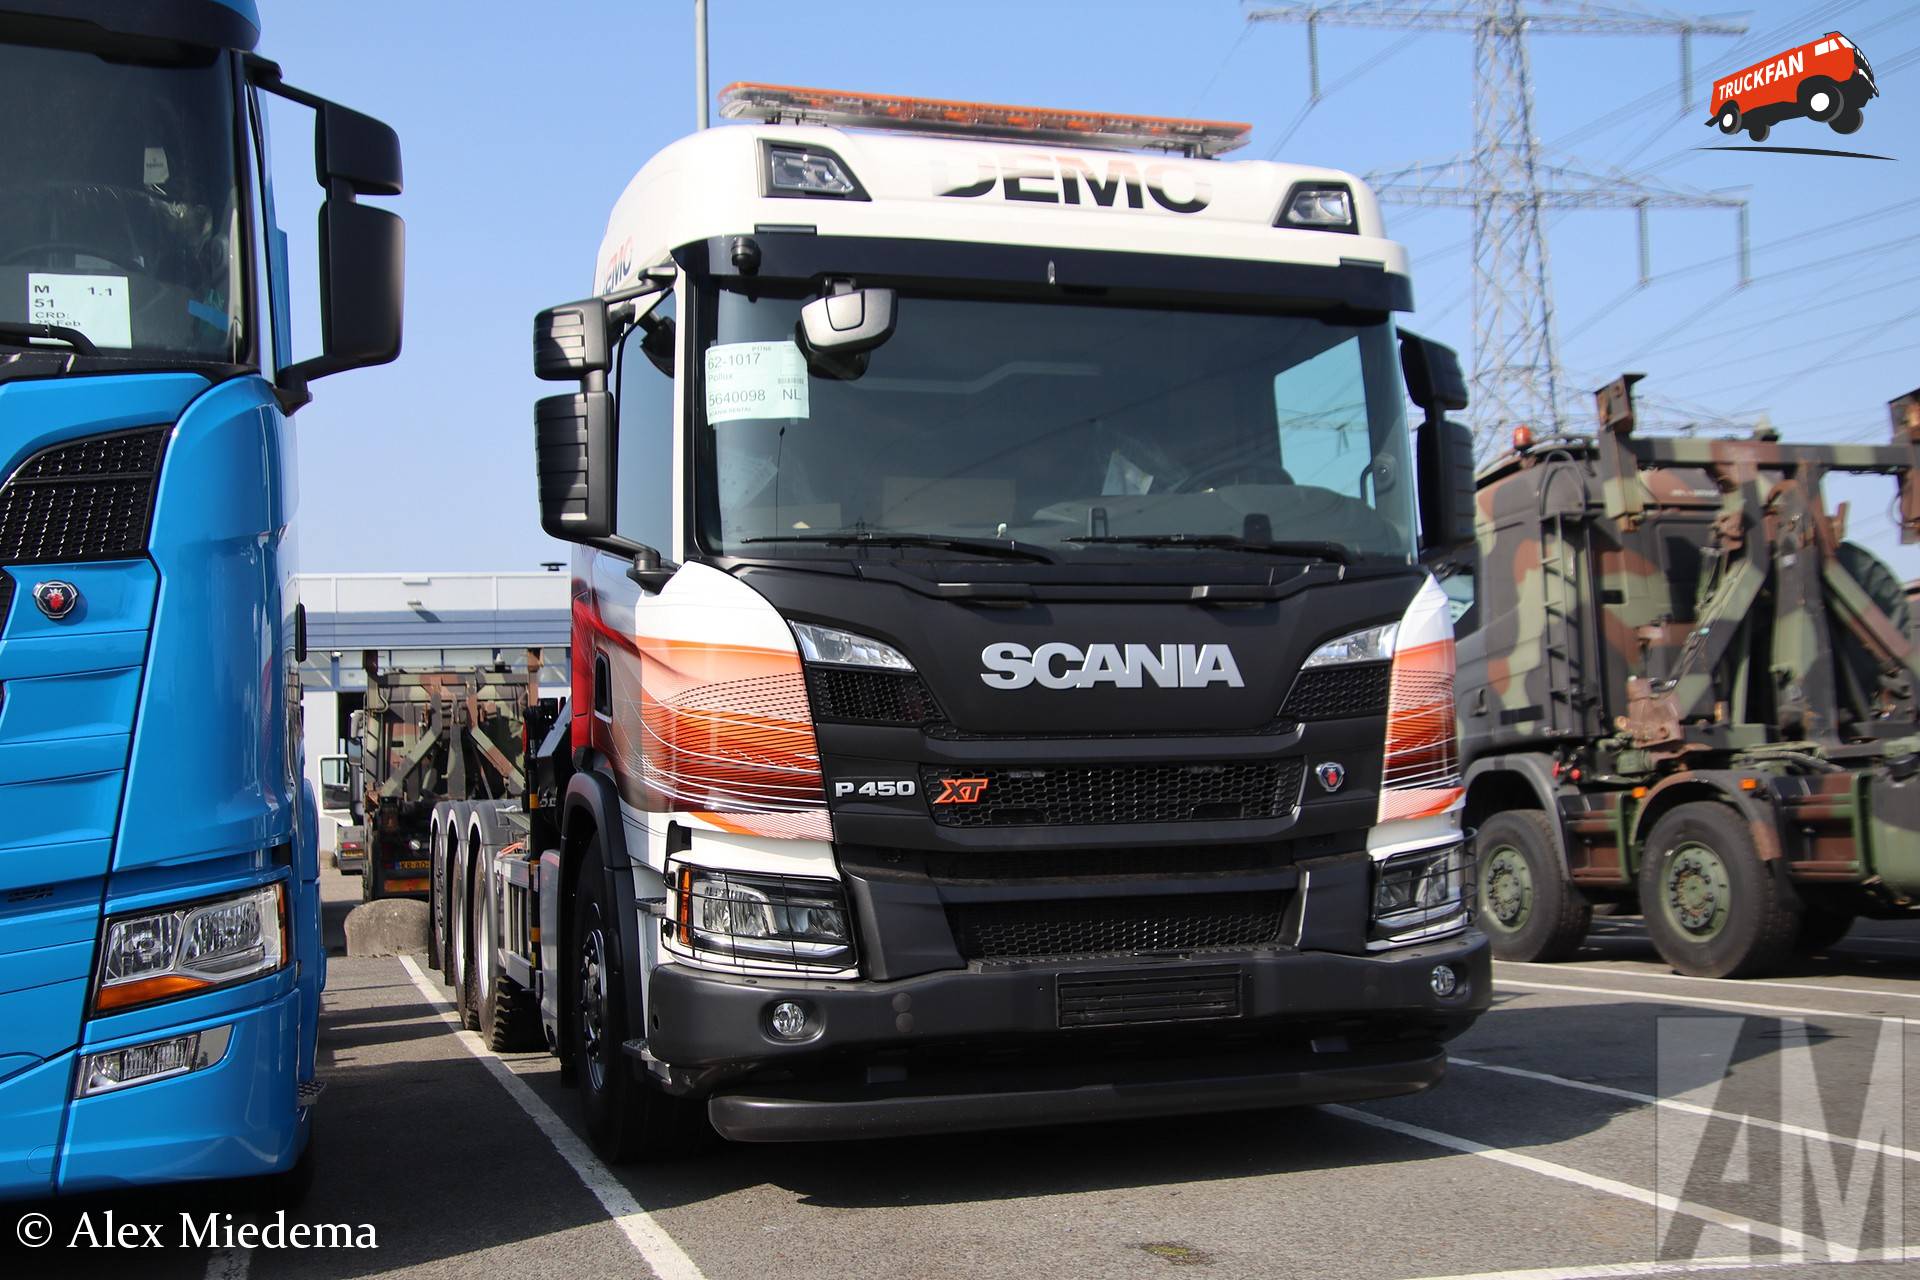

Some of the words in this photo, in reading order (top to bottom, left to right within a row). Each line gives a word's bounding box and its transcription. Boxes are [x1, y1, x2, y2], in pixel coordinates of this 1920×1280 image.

[34, 285, 50, 293] M
[87, 287, 113, 297] 1.1
[34, 299, 55, 308] 51
[782, 388, 802, 401] NL
[980, 641, 1246, 690] SCANIA
[834, 782, 855, 798] P
[858, 780, 916, 797] 450
[932, 777, 989, 804] XT
